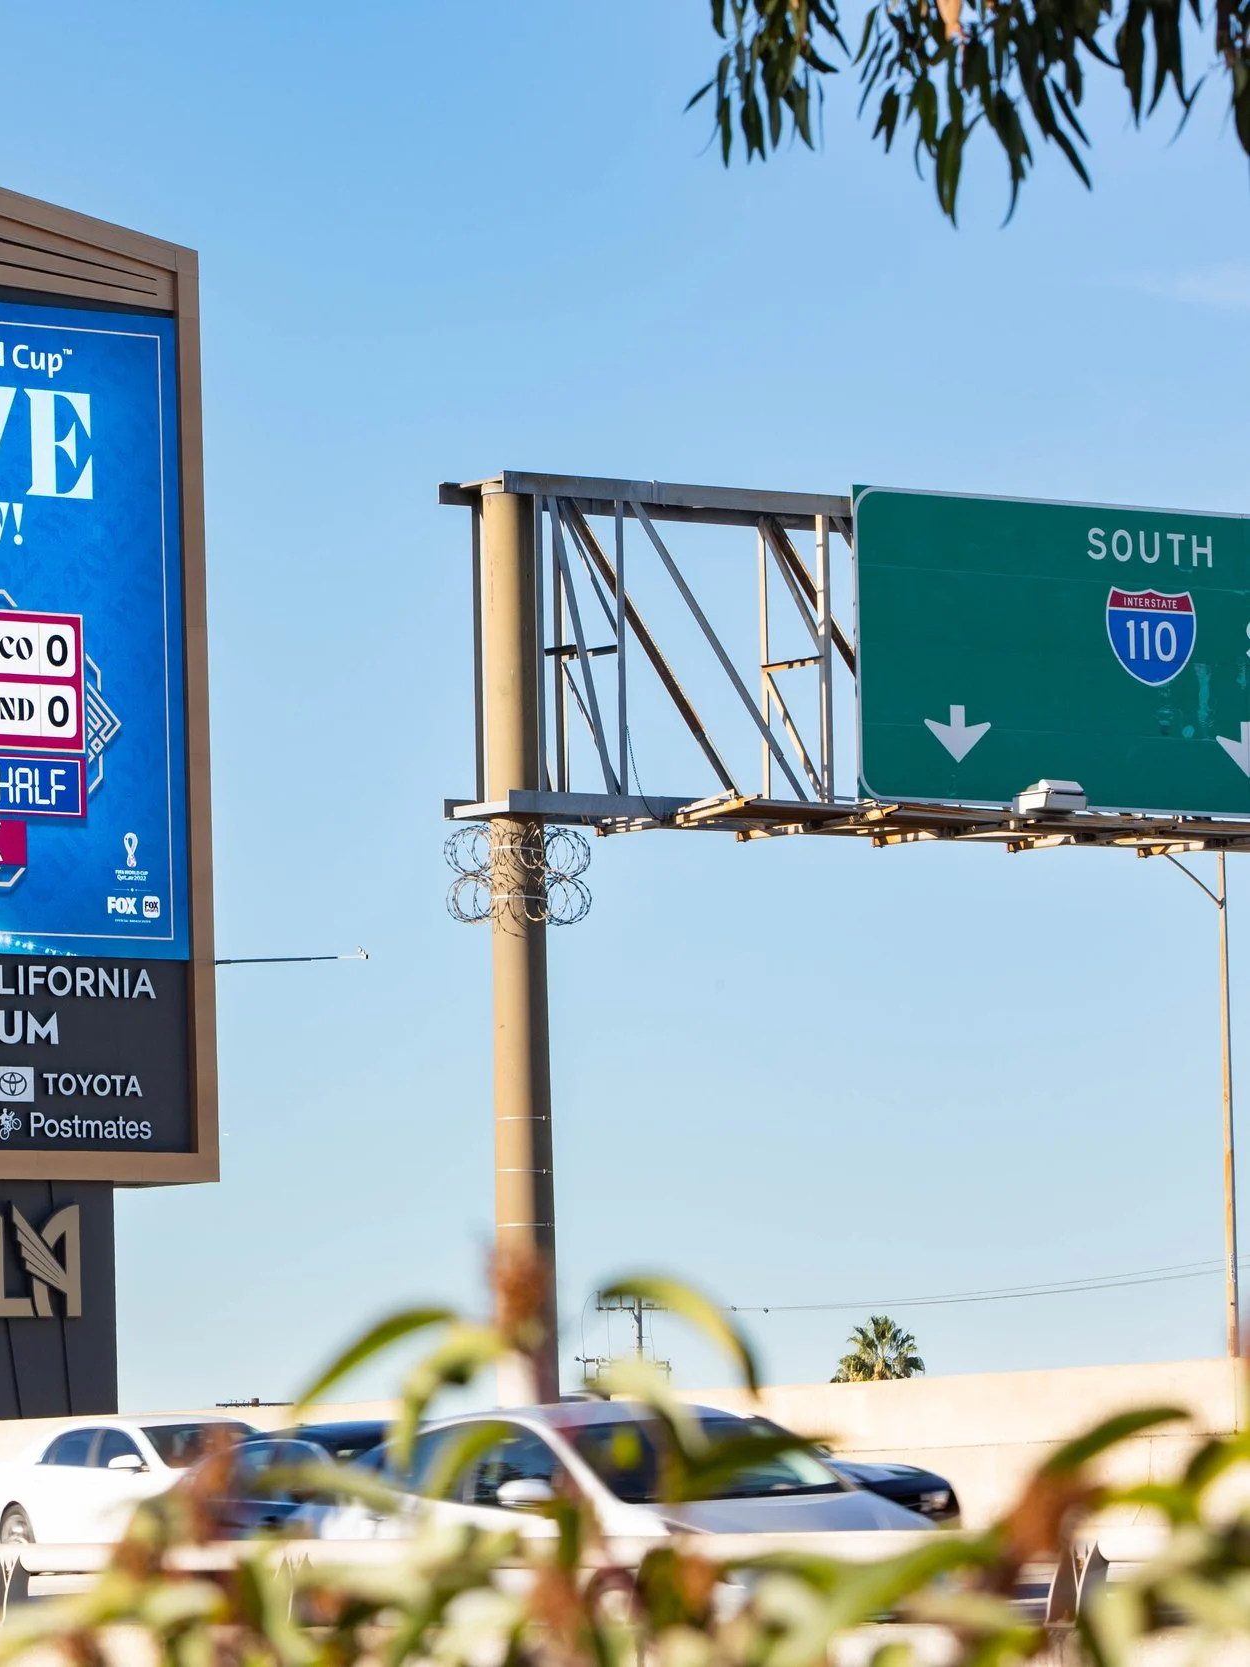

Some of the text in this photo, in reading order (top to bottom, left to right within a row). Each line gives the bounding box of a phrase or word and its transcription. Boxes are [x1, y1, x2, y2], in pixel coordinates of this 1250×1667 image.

[1087, 527, 1213, 568] SOUTH
[1123, 597, 1178, 610] INTERSTATE
[46, 634, 68, 667] 0
[1126, 620, 1177, 662] 110
[48, 695, 69, 728] 0
[107, 896, 138, 915] FOX
[144, 901, 158, 909] FOX
[42, 1072, 143, 1098] TOYOTA
[29, 1112, 153, 1140] Postmates
